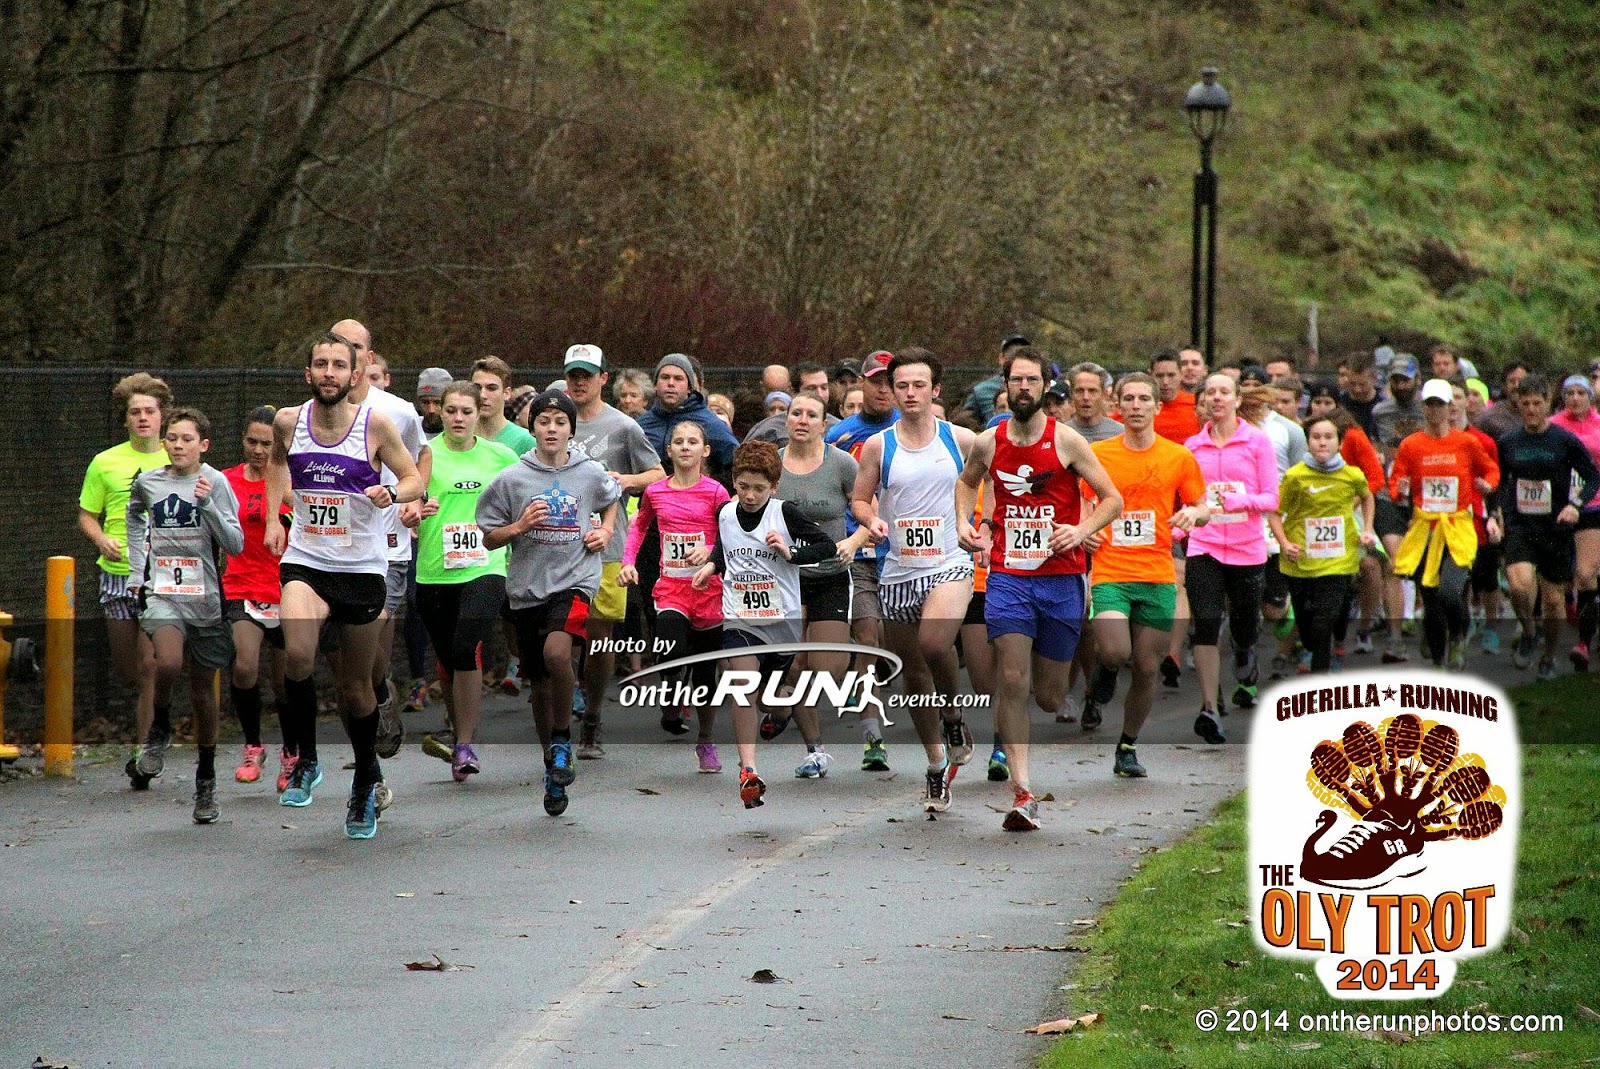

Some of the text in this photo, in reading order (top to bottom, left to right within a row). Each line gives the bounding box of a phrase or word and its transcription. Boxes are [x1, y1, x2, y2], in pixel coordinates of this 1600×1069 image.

[303, 461, 346, 477] Linfield
[302, 495, 346, 505] OLY TROT
[309, 505, 338, 525] 579
[1006, 504, 1056, 519] RWB
[898, 519, 941, 528] OLY TROT
[1008, 521, 1049, 529] OLY TROT
[1124, 520, 1141, 537] 83
[325, 527, 348, 535] GOBBLE
[524, 530, 580, 542] HAMPIONSHIPS
[906, 528, 934, 547] 850
[1315, 525, 1338, 542] 229
[453, 532, 477, 550] 940
[681, 534, 702, 542] TROT
[1014, 529, 1042, 549] 264
[755, 548, 779, 562] park
[920, 548, 942, 556] GOBBLE
[1028, 550, 1051, 559] GOBBLE
[157, 559, 199, 567] OLY TROT
[173, 567, 182, 585] 8
[734, 582, 775, 591] OLY TROT
[743, 591, 770, 609] 490
[758, 608, 780, 617] GOBBLE
